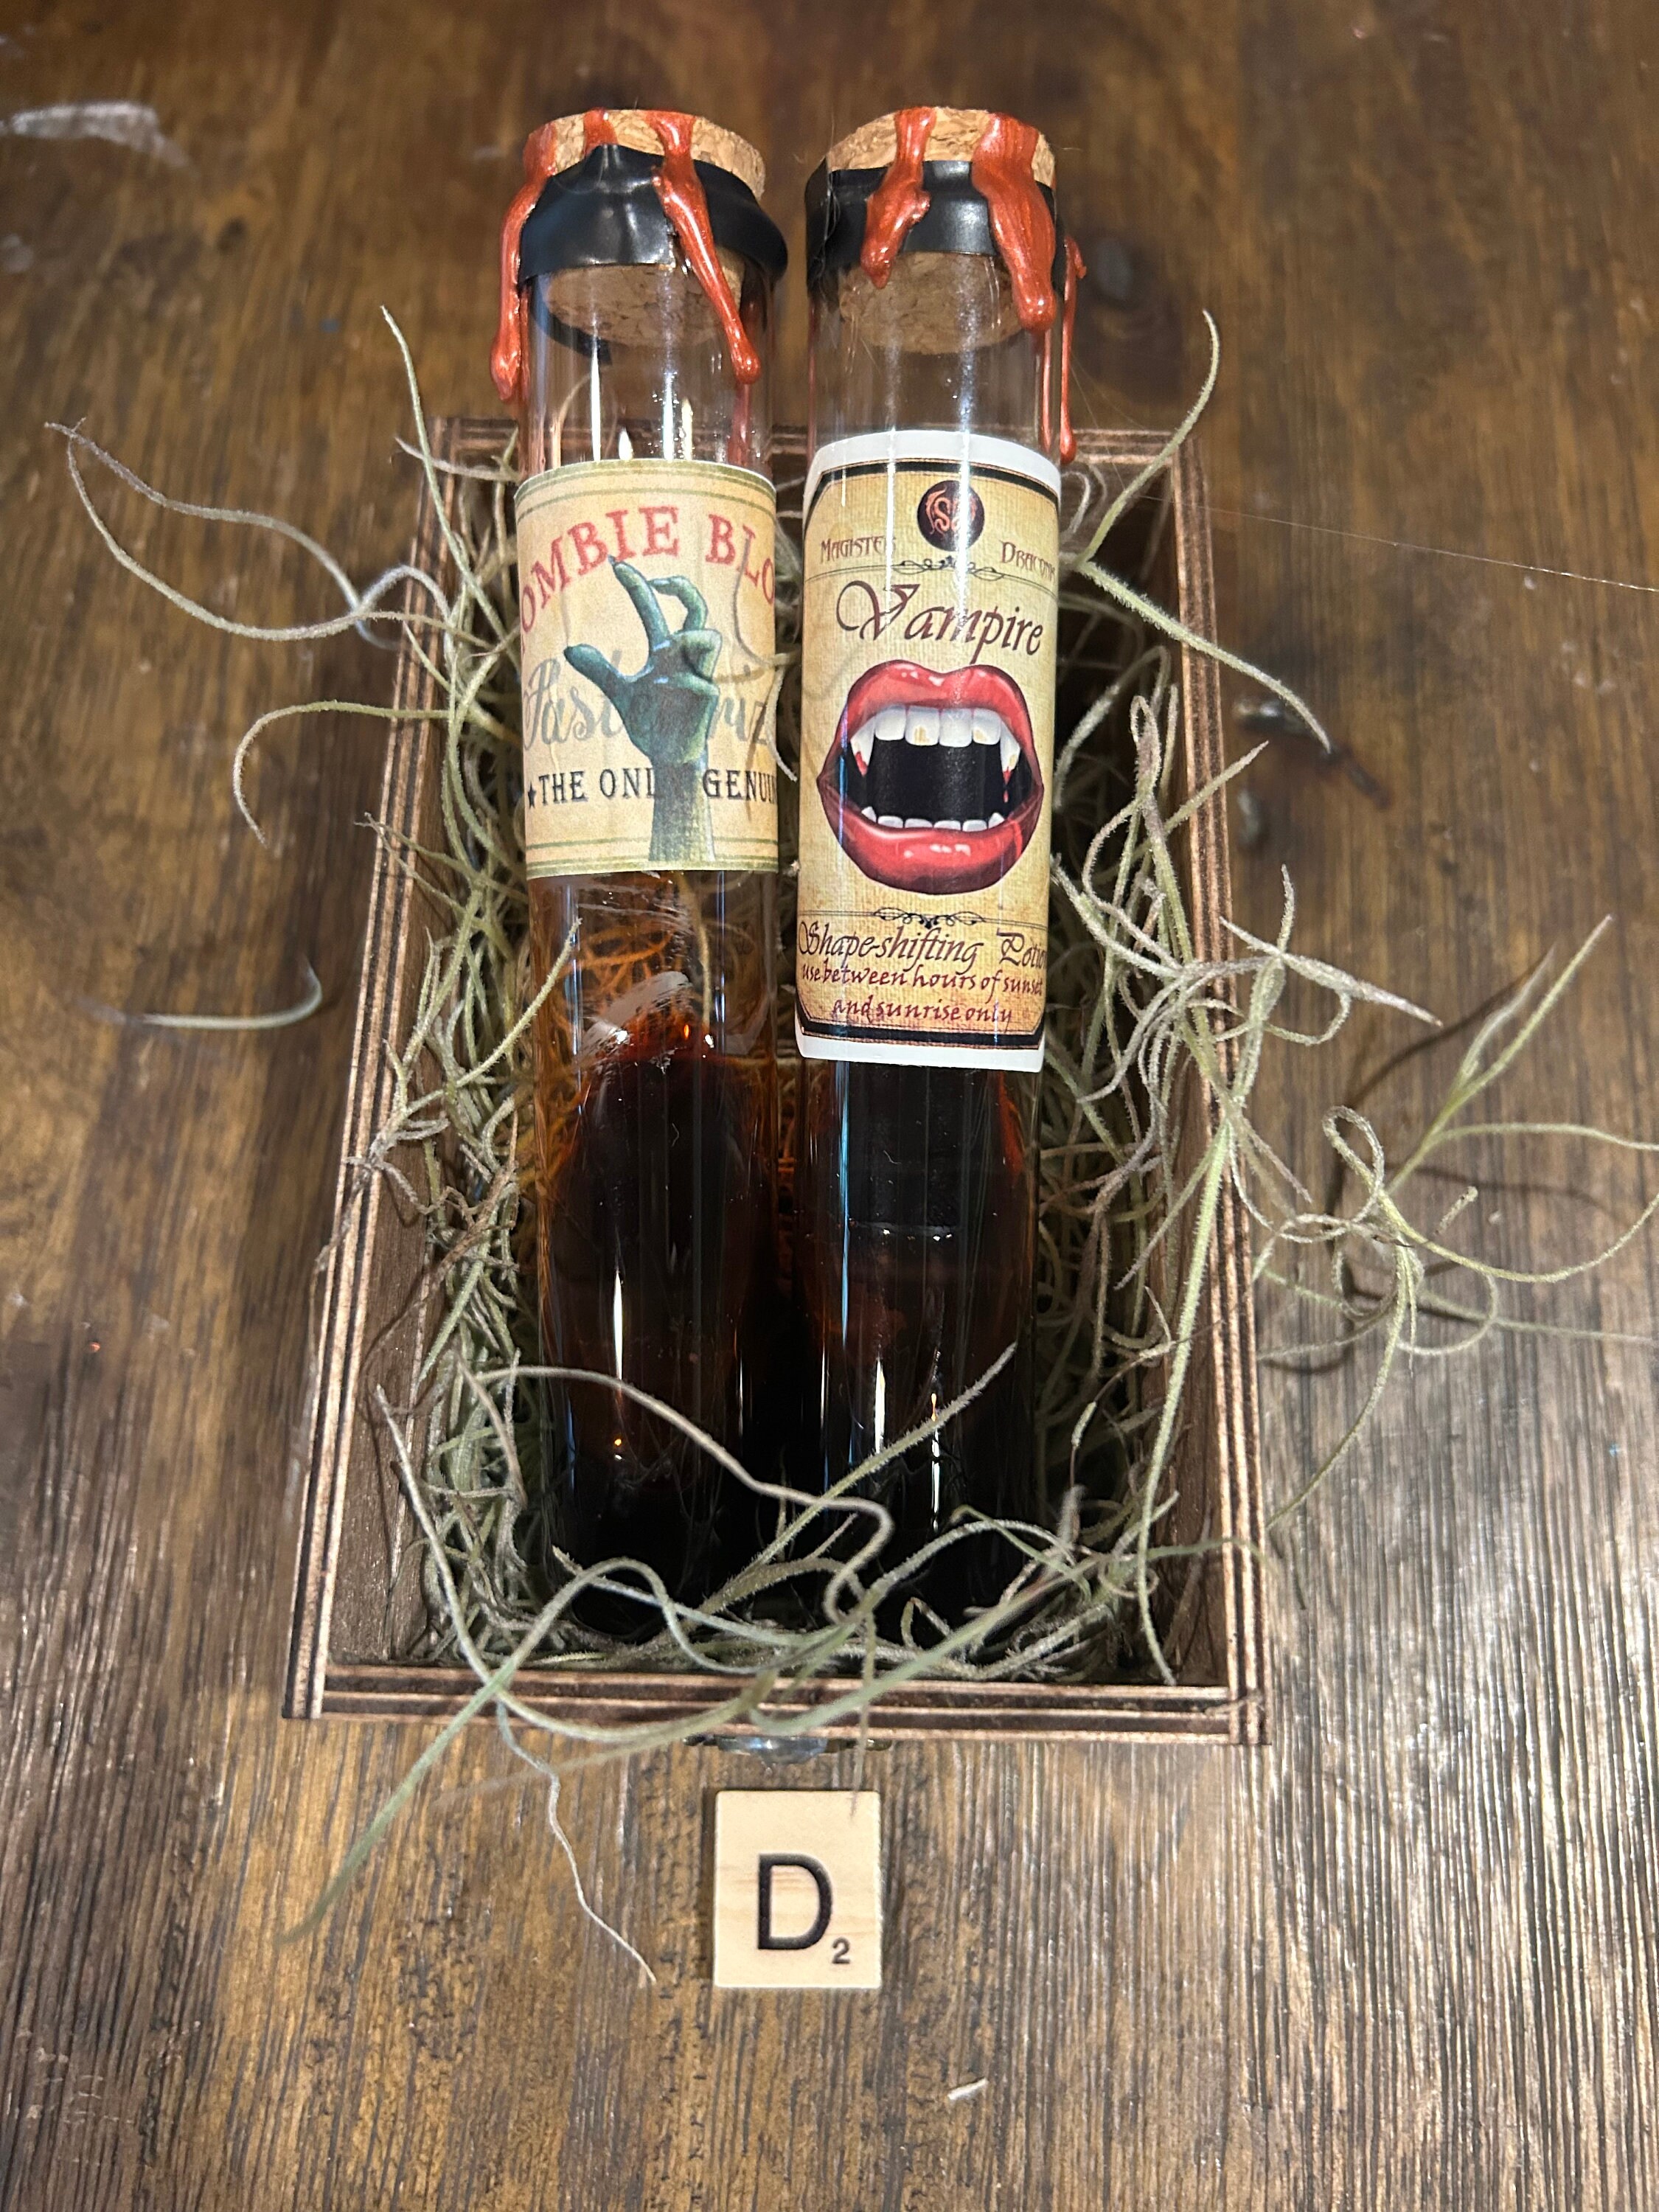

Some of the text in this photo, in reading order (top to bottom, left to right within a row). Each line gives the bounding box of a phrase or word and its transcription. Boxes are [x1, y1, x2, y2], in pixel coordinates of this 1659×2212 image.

[519, 504, 680, 636] OMBIE
[836, 580, 1044, 664] Vampire
[538, 771, 588, 805] THE
[599, 768, 658, 799] ONL
[799, 920, 984, 975] Shape-shifting
[802, 958, 1043, 1005] use between hours of sunset
[832, 994, 1013, 1033] and sunrise only
[757, 1853, 851, 1965] D 2
